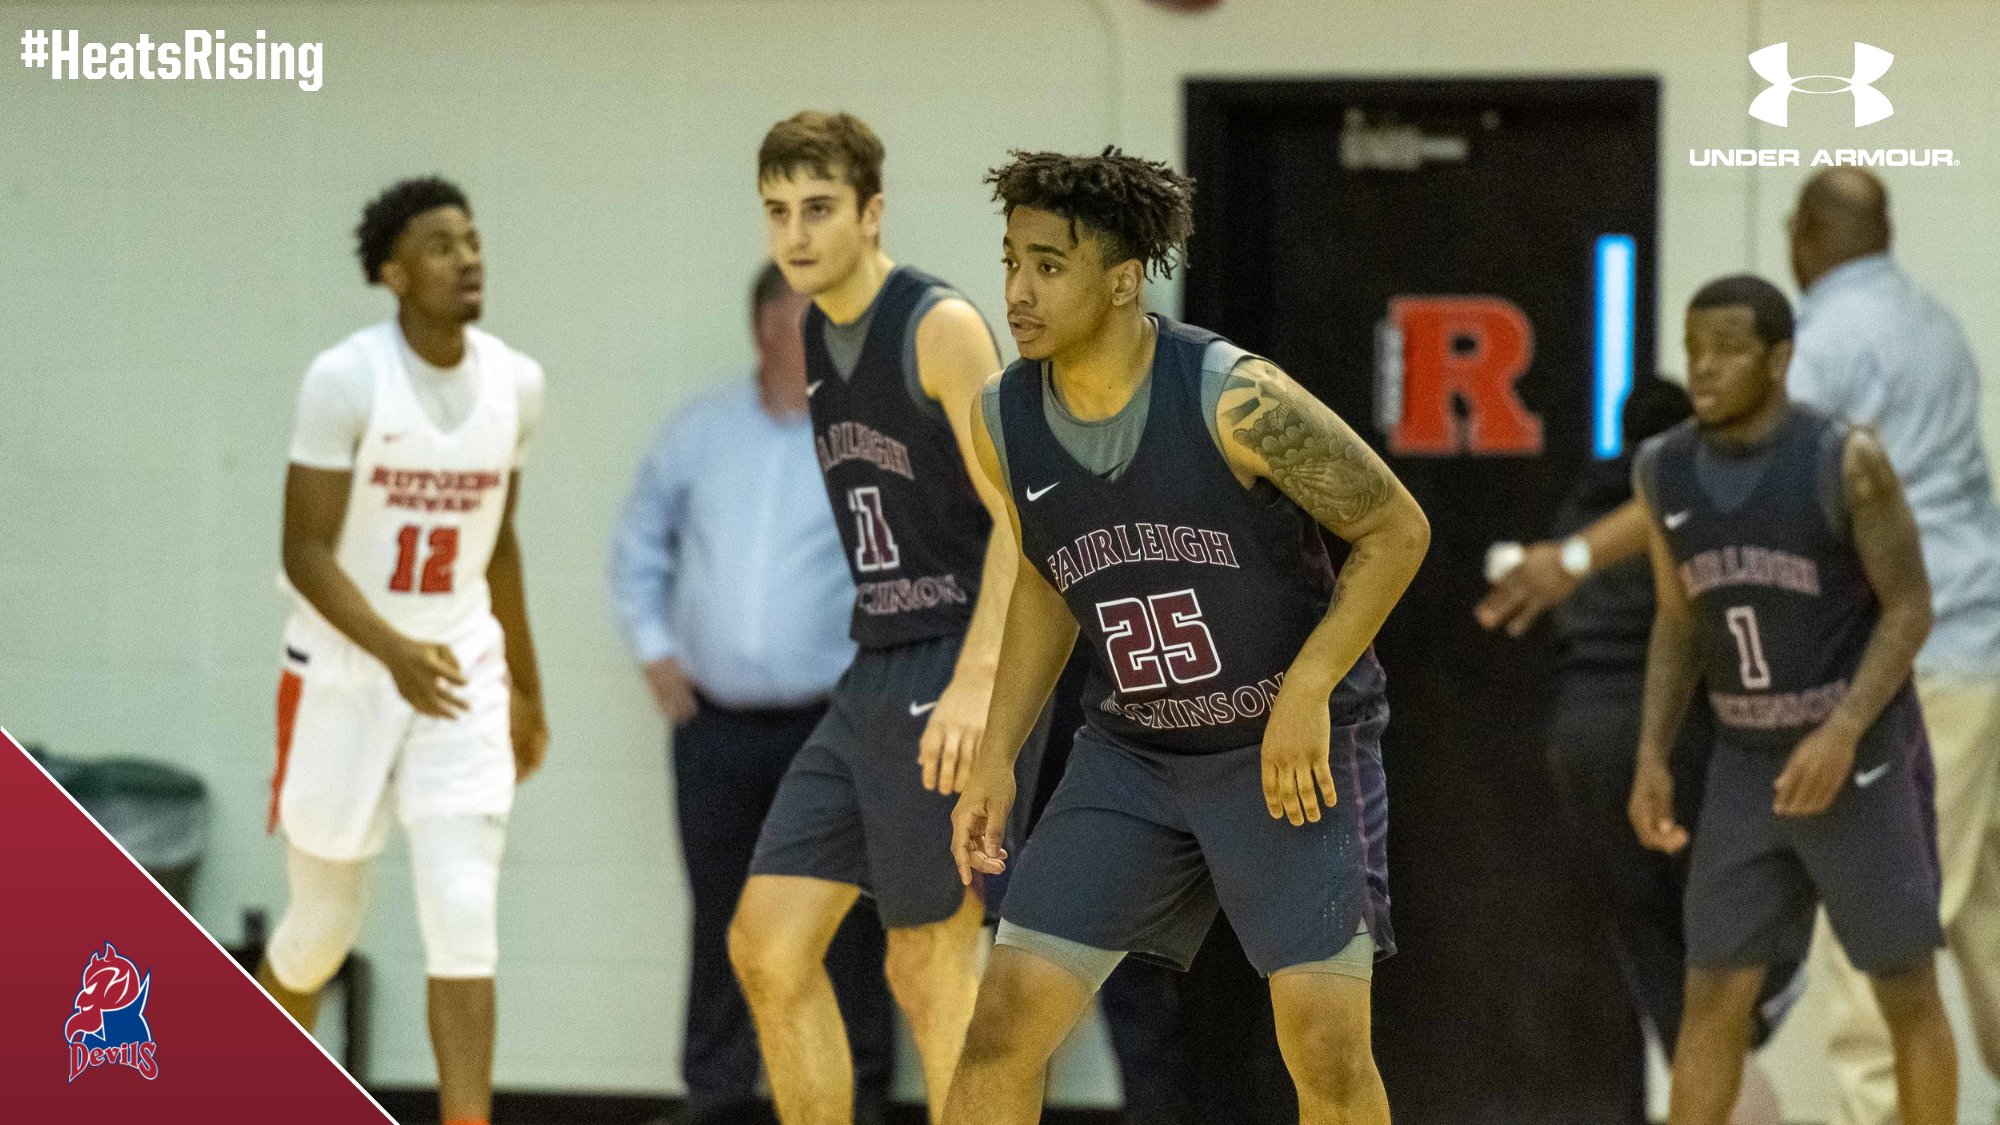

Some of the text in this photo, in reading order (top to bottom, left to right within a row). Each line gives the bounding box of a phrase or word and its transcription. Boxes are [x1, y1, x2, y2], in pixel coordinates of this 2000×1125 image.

[1388, 293, 1543, 456] R
[388, 523, 461, 594] 12
[1095, 588, 1222, 692] 25
[1725, 605, 1772, 690] 1
